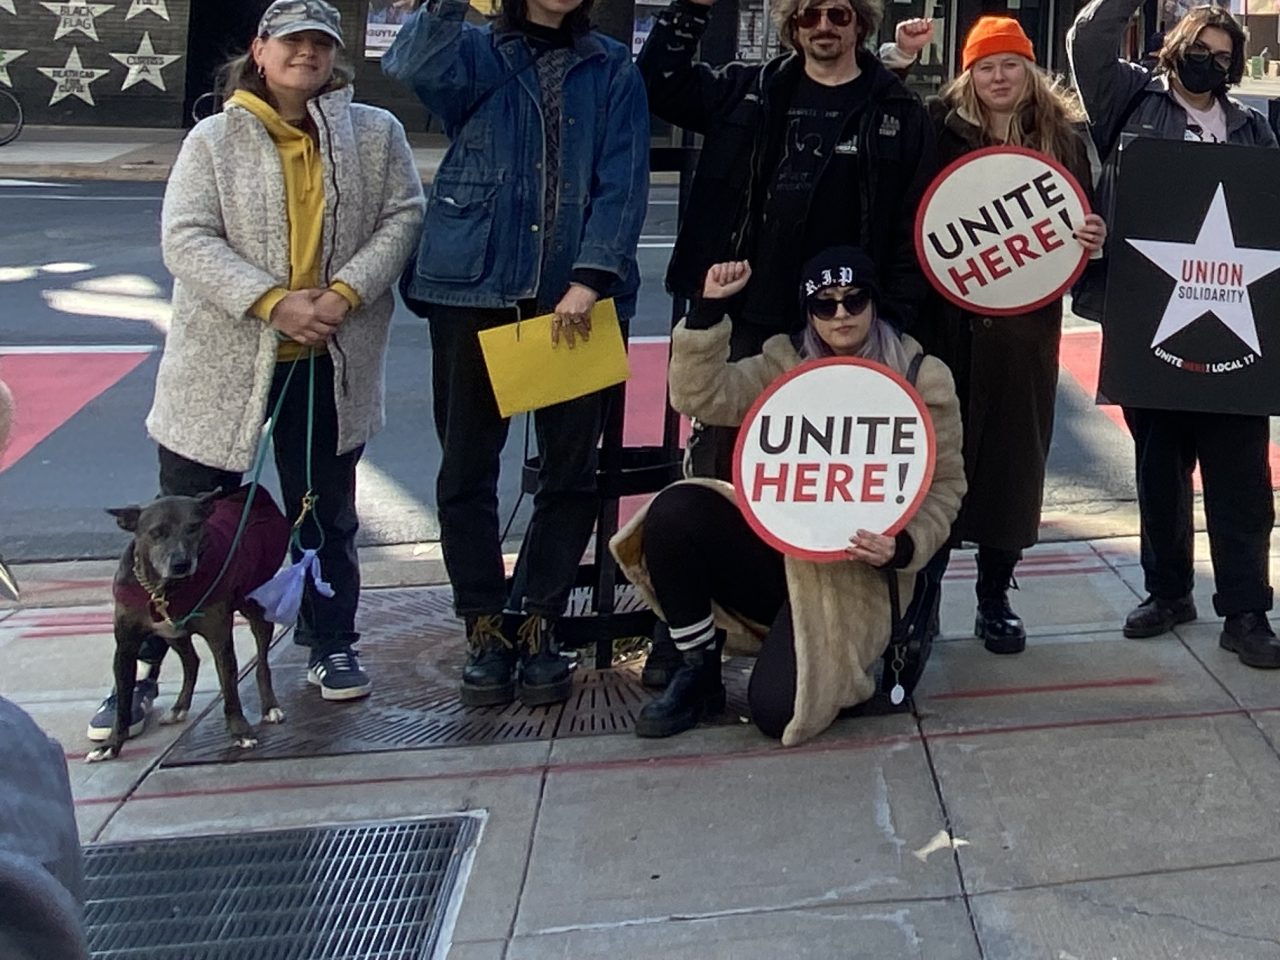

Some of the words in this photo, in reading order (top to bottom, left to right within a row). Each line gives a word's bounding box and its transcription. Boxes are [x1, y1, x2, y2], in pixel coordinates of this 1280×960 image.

[60, 6, 95, 17] BLACK
[63, 17, 91, 29] FLAG
[927, 170, 1065, 260] UNITE
[947, 207, 1078, 297] HERE!
[1182, 260, 1243, 287] UNION
[1178, 286, 1245, 304] SOLIDARITY
[1212, 359, 1243, 373] LOCAL
[1243, 354, 1254, 365] 17
[759, 415, 917, 456] UNITE
[752, 462, 909, 504] HERE!
